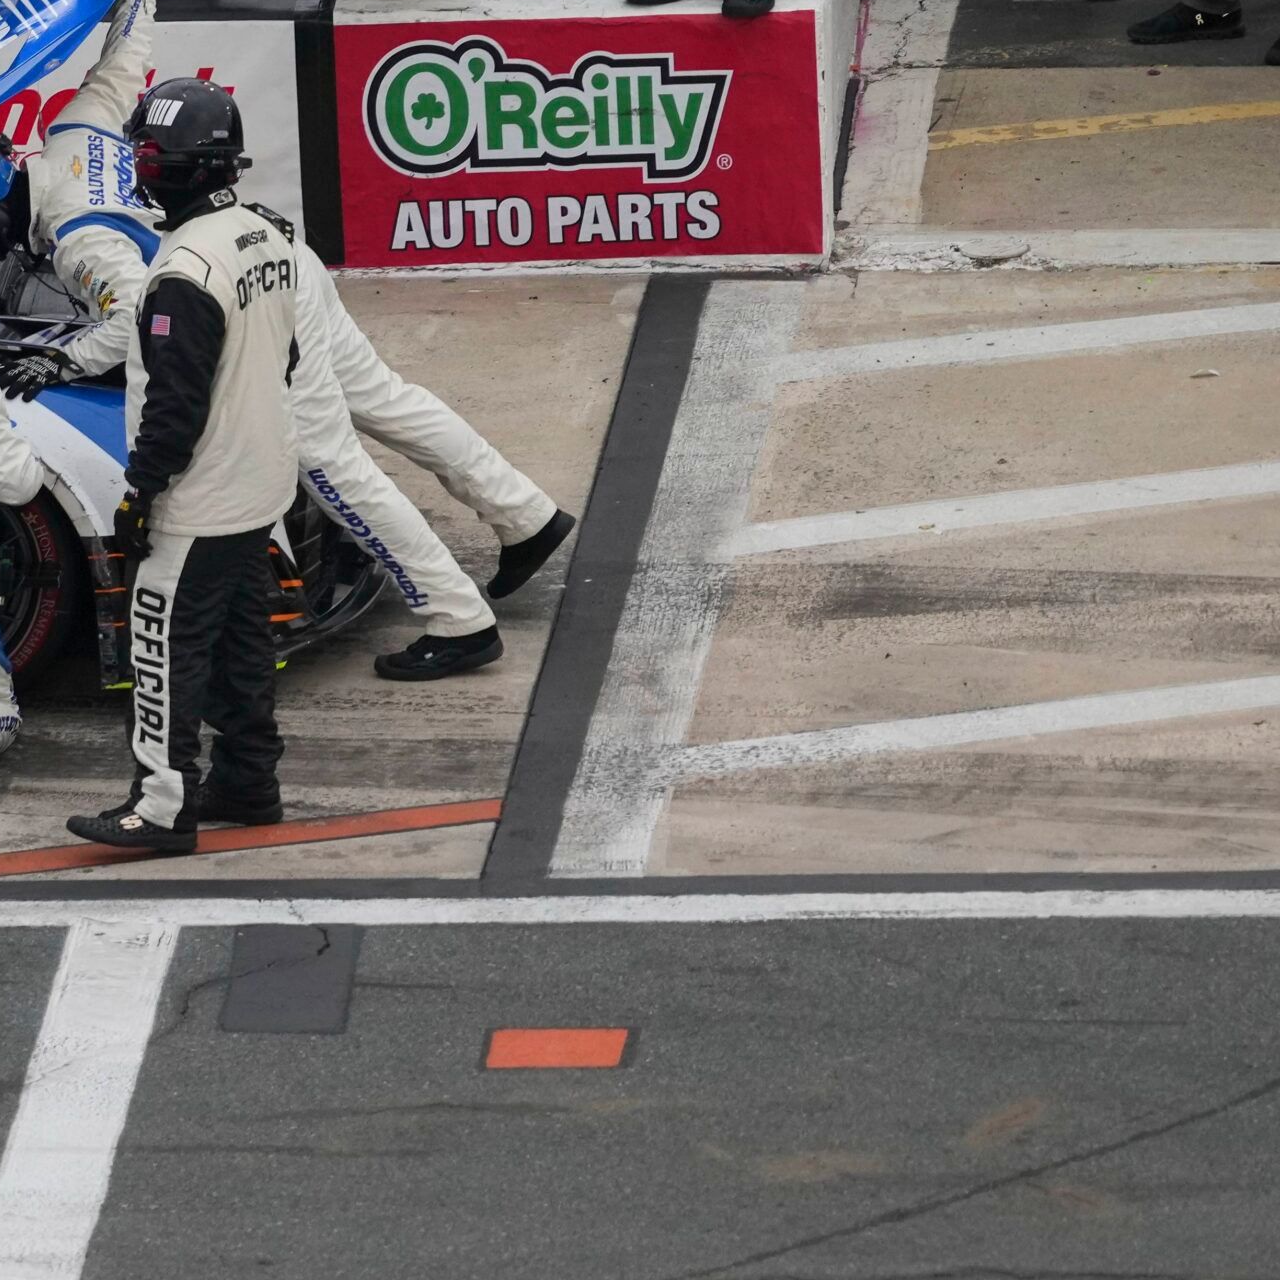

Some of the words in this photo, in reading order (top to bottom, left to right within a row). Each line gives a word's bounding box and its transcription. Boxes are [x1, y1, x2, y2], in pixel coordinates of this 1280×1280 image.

[384, 56, 705, 162] O'Reilly
[88, 135, 105, 206] SAUNDERS
[111, 141, 139, 213] Hendric
[390, 196, 533, 251] AUTO
[547, 190, 721, 246] PARTS
[307, 467, 429, 611] HendrickCars.com
[134, 587, 168, 746] OFFICIAL
